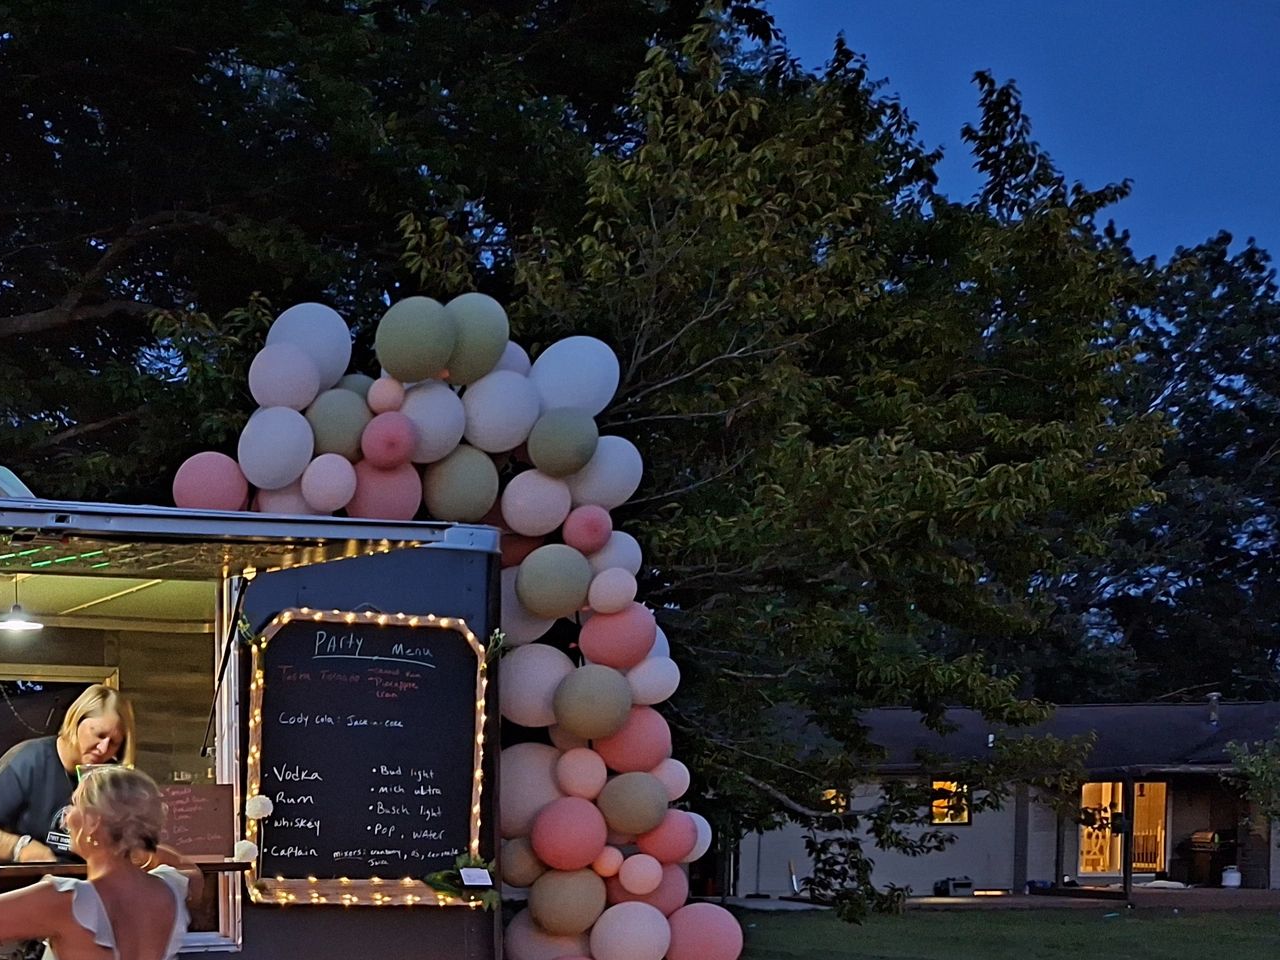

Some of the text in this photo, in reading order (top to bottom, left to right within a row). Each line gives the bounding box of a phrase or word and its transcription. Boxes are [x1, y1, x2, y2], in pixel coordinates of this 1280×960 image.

[392, 643, 433, 658] Menu
[279, 712, 309, 727] Cody
[273, 763, 323, 782] Vodka
[380, 765, 402, 776] Bud
[276, 792, 315, 805] Rum
[376, 801, 410, 815] Busch
[271, 847, 318, 858] Captain
